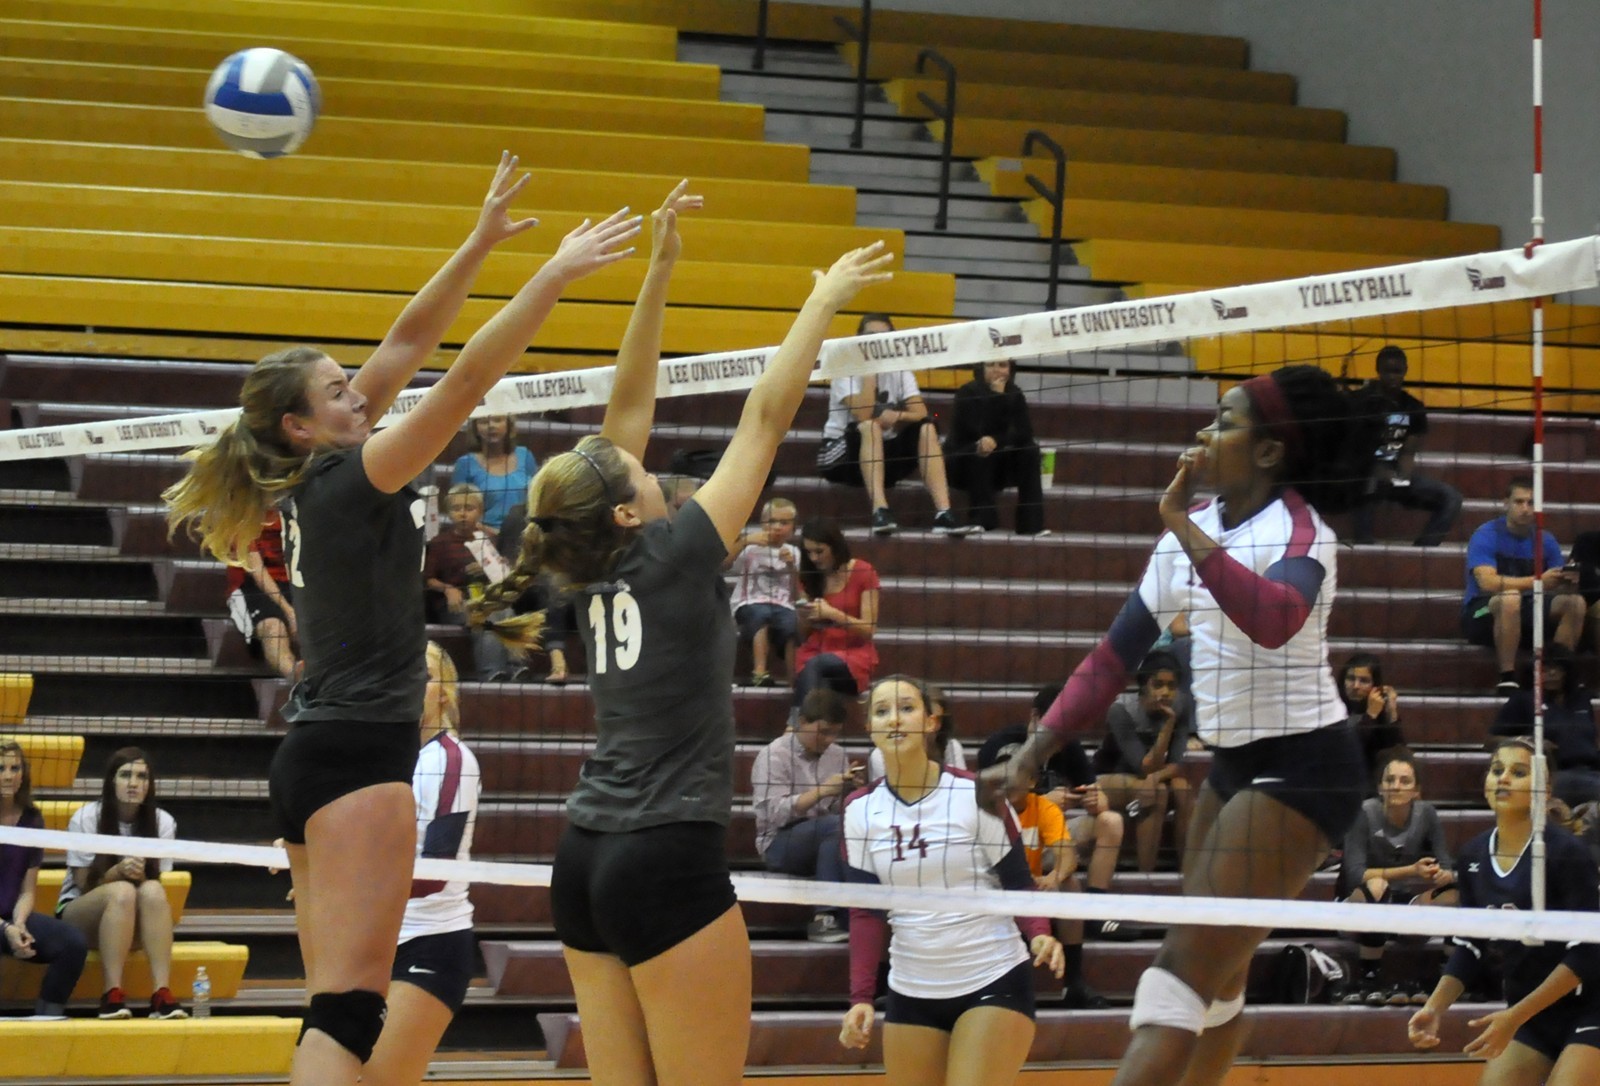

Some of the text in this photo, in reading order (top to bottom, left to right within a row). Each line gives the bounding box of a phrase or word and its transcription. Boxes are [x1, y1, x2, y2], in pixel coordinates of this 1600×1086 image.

[1298, 273, 1412, 309] VOLLEYBALL
[1050, 302, 1176, 338] LEE UNIVERSITY
[858, 332, 948, 361] VOLLEYBALL
[667, 354, 766, 384] LEE UNIVERSITY
[515, 376, 587, 400] VOLLEYBALL
[588, 592, 642, 674] 19
[890, 824, 929, 862] 14
